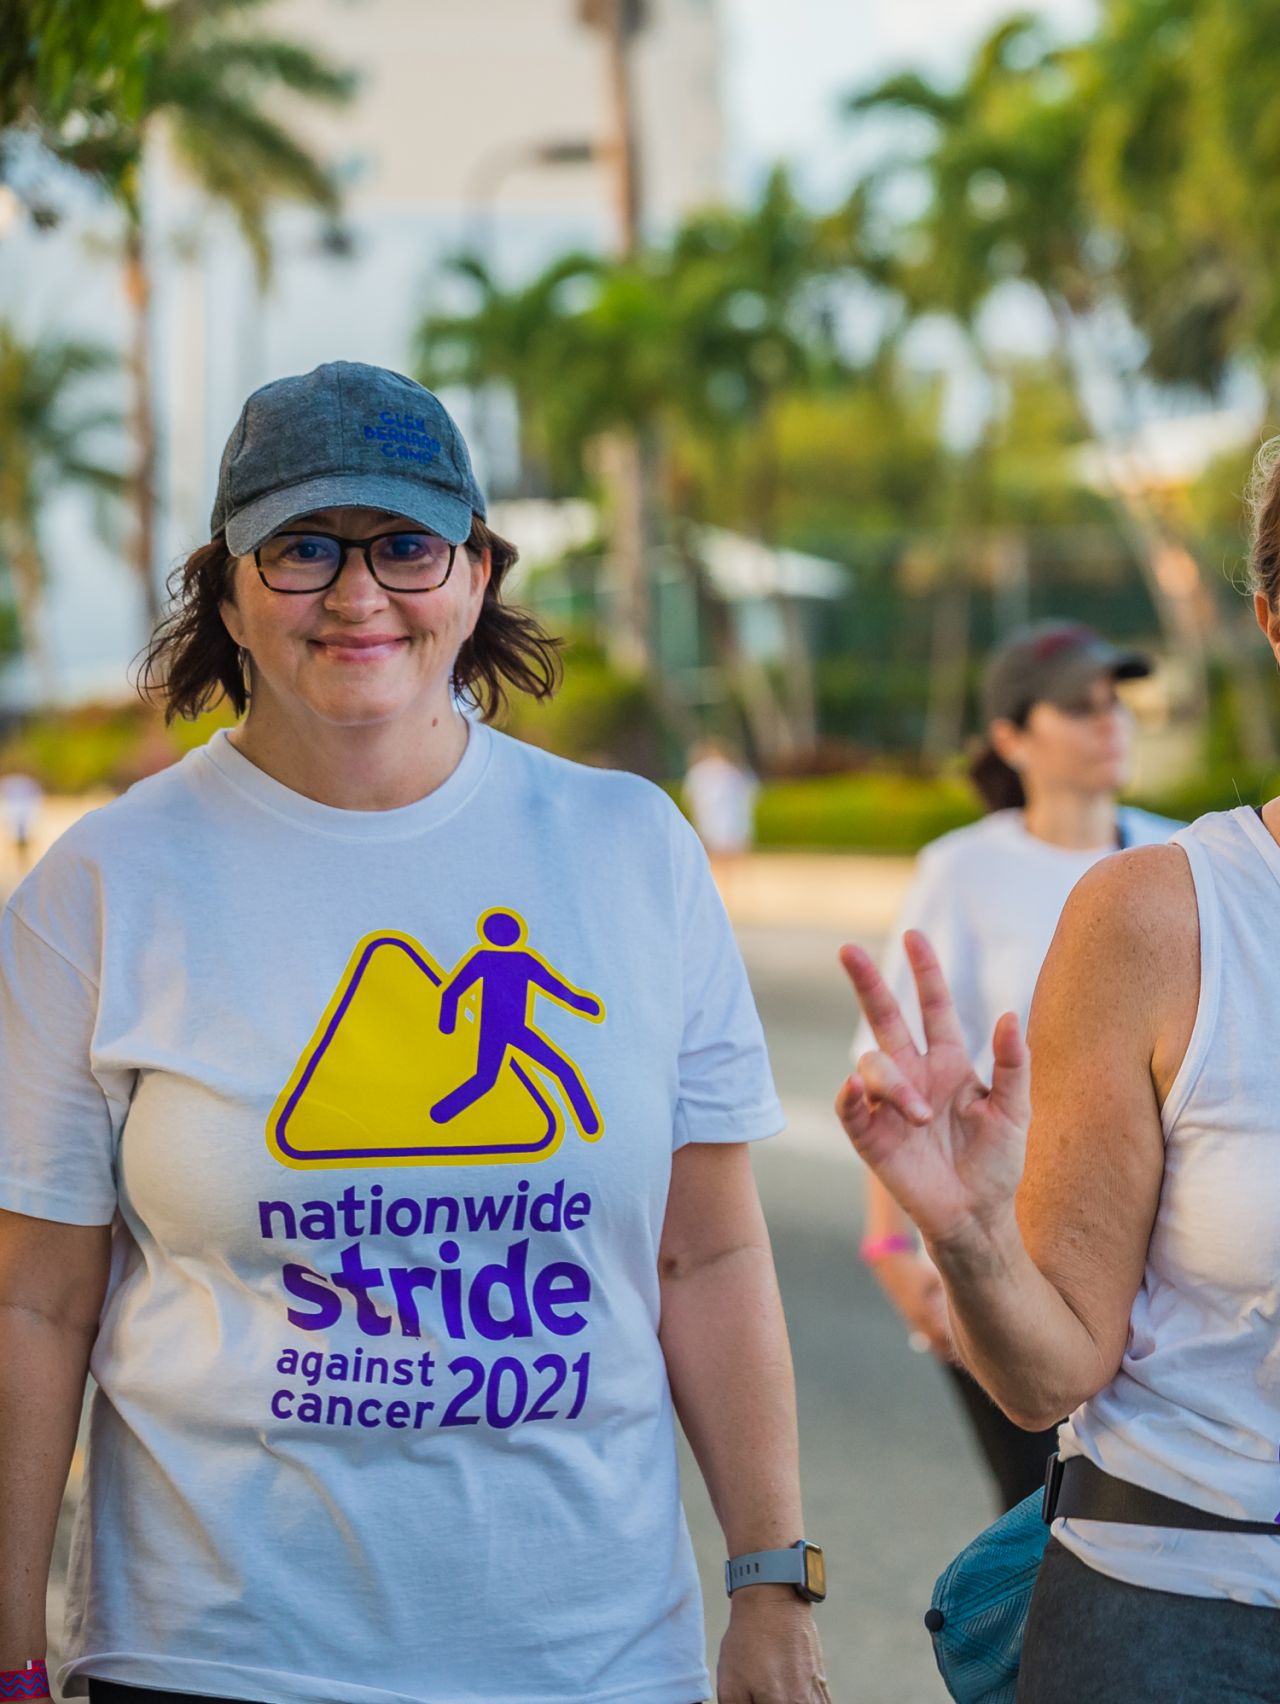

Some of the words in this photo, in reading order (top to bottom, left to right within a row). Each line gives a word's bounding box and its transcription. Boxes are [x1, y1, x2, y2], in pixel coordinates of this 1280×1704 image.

[258, 1178, 592, 1241] nationwide
[282, 1237, 591, 1341] stride
[271, 1389, 435, 1429] cancer
[438, 1351, 591, 1429] 2021
[276, 1347, 436, 1387] against
